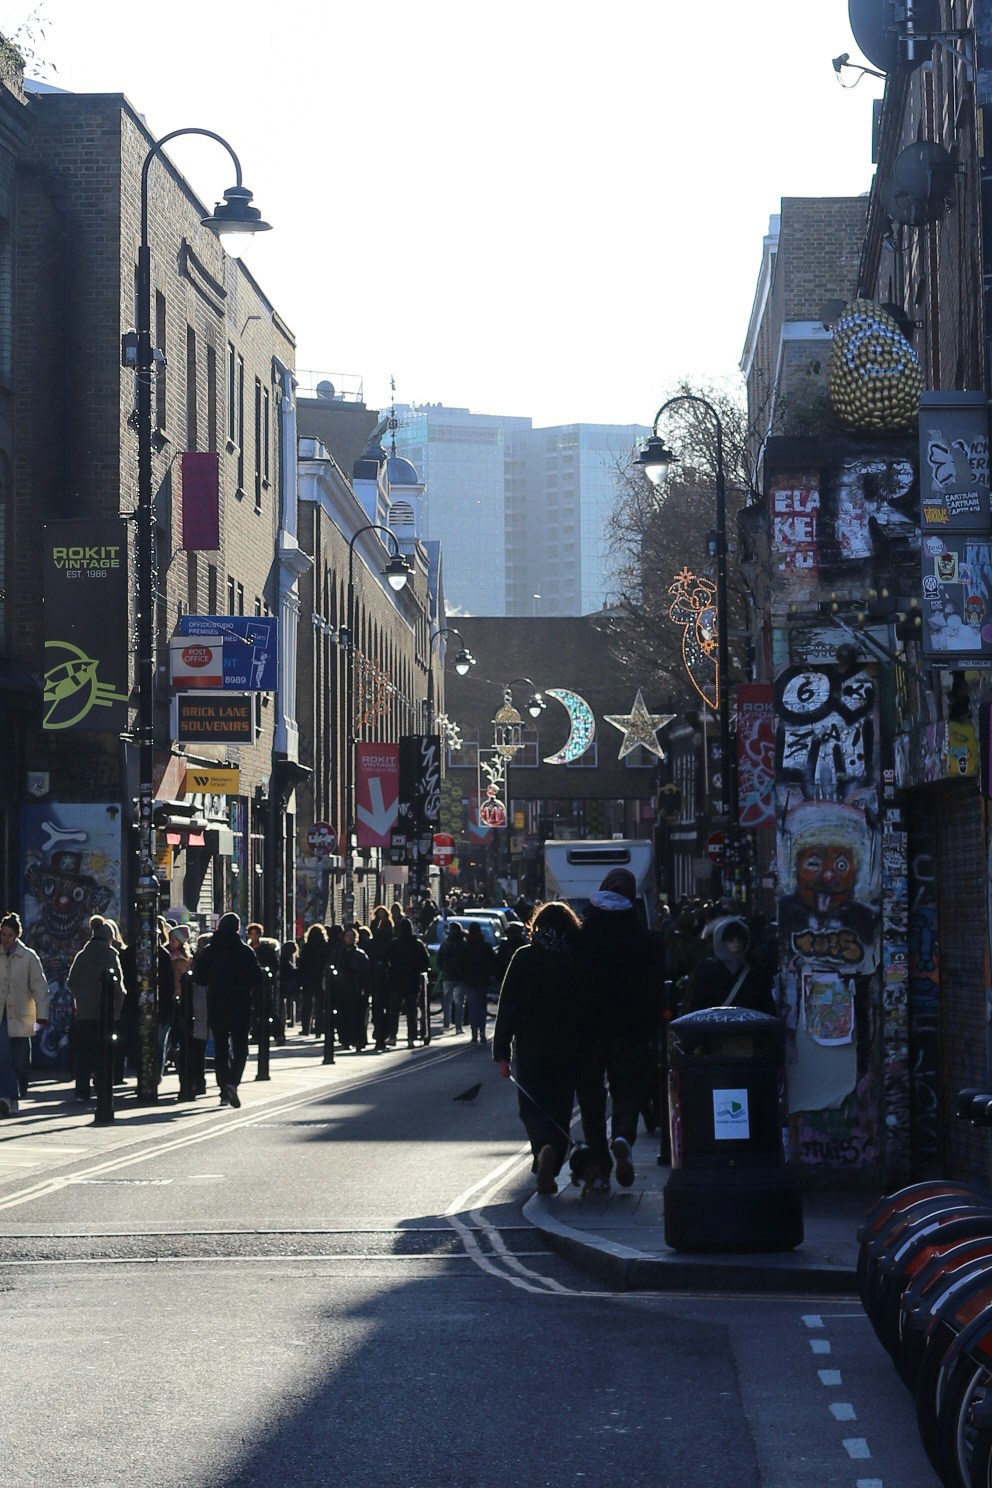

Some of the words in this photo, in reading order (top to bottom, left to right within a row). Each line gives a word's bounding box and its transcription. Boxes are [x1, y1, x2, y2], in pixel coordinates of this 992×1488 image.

[53, 546, 120, 559] ROKIT
[53, 559, 120, 569] VINTAGE
[86, 569, 107, 578] 1986
[225, 676, 247, 684] 8989
[182, 707, 215, 717] BRICK
[219, 707, 248, 717] LANE
[180, 721, 250, 731] SOUVENIRS
